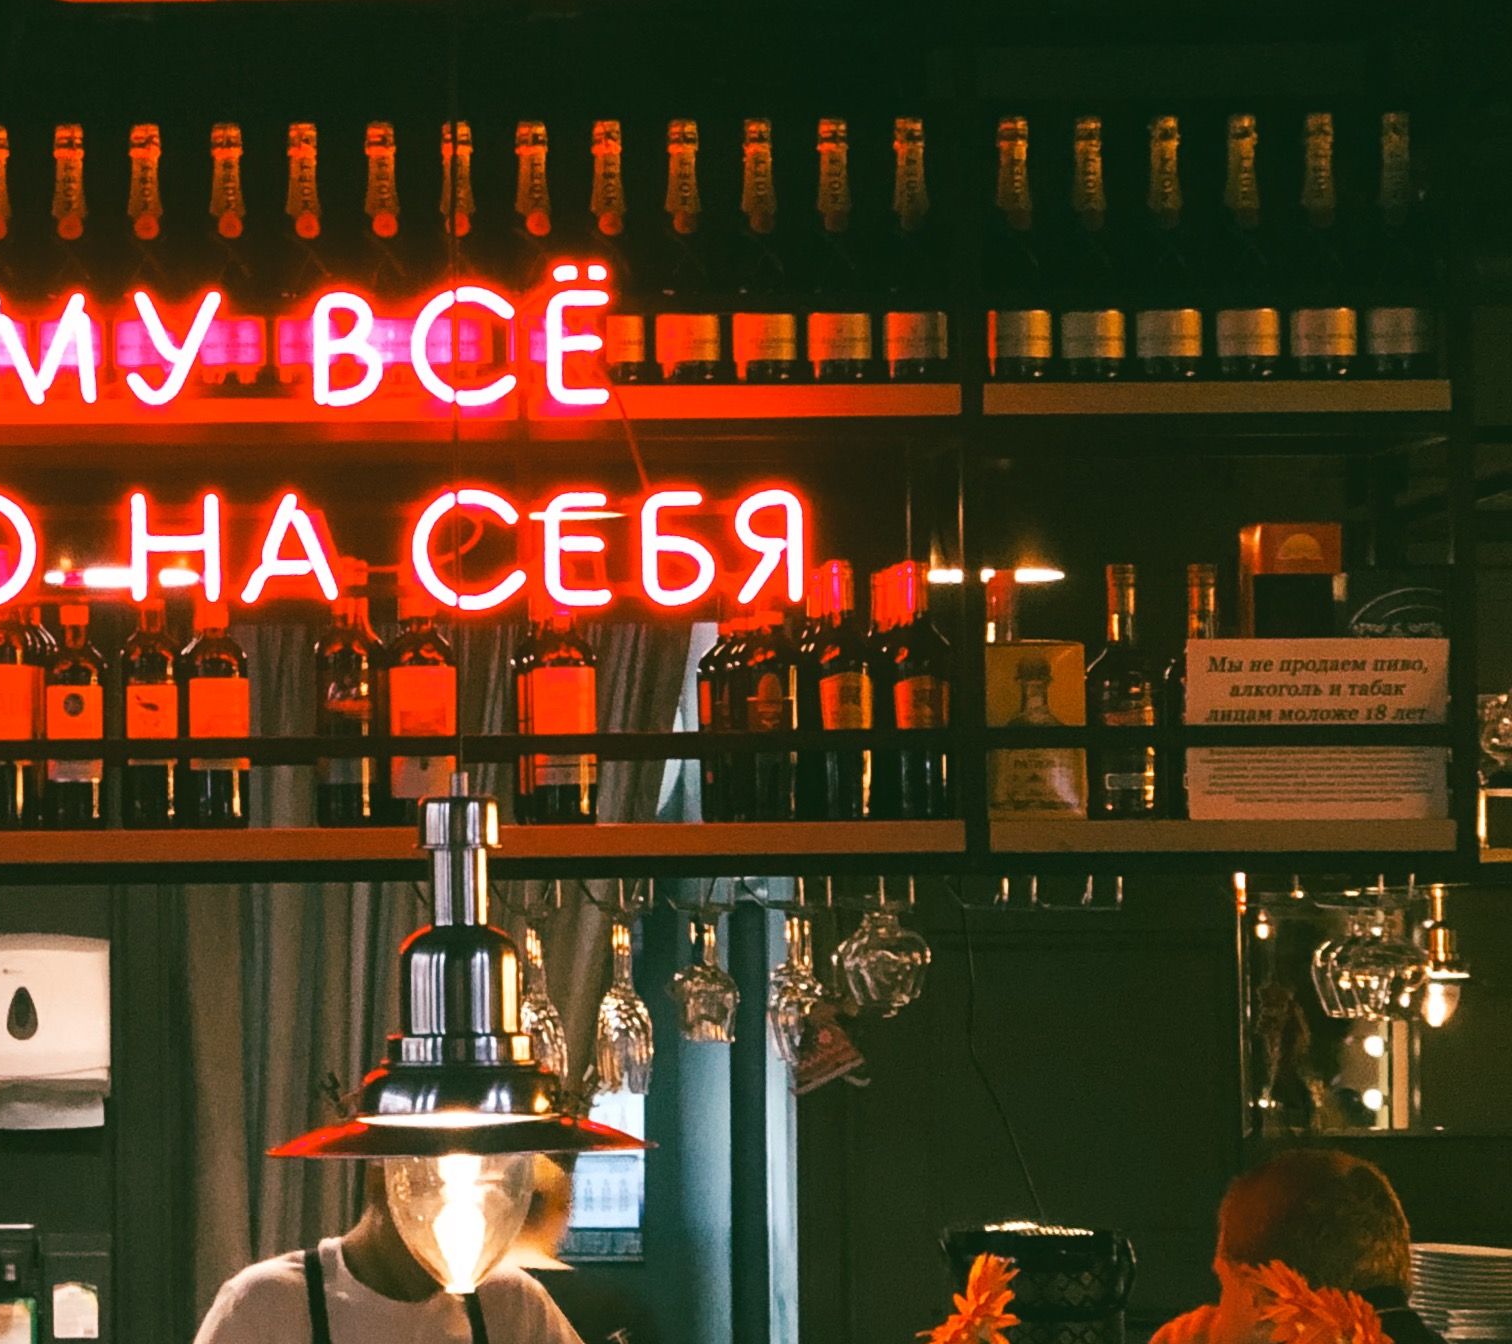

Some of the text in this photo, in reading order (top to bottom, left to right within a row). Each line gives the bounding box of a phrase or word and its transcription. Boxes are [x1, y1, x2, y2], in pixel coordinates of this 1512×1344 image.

[312, 263, 610, 408] ВСЁ
[129, 492, 340, 604] НА
[411, 487, 804, 611] СЕБЯ
[1207, 656, 1430, 676] Мы не продаем пиво,
[1228, 679, 1407, 697] алкоголь и табак
[1205, 704, 1429, 723] лицам моложе 18 лет
